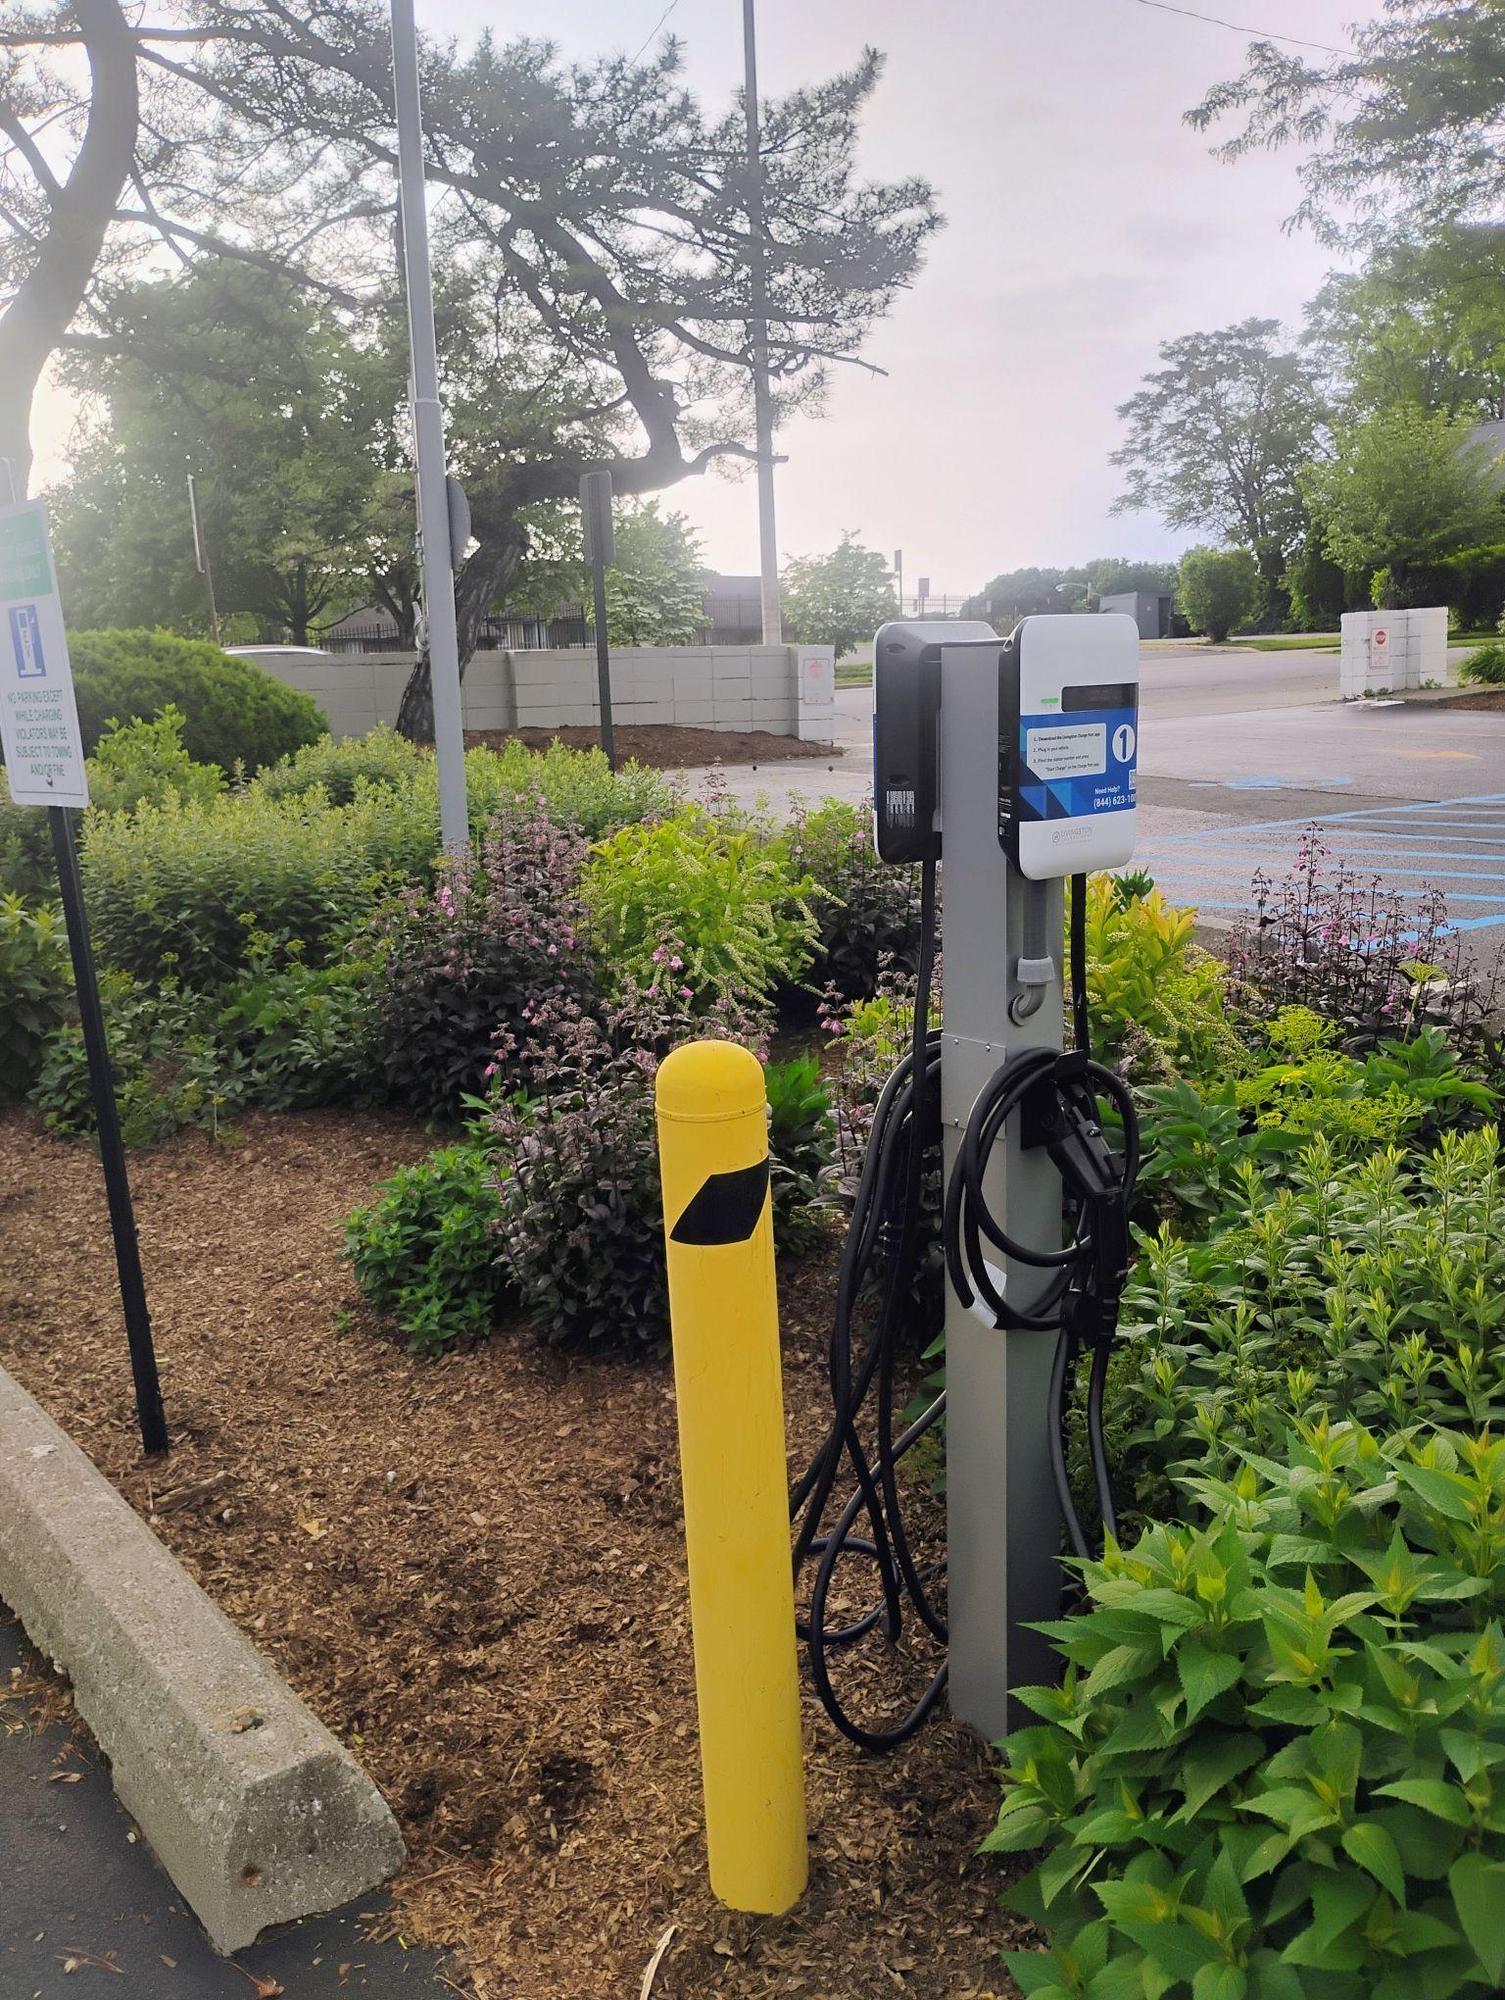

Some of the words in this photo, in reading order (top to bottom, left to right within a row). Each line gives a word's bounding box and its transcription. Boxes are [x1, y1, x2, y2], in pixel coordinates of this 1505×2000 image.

[7, 692, 17, 704] NO
[17, 691, 42, 703] PARKING
[43, 689, 63, 703] EXCEPT
[15, 709, 34, 721] WHILE
[34, 708, 63, 721] CHARGING
[16, 727, 47, 740] VIOLATORS
[47, 727, 59, 740] MAY
[59, 727, 67, 740] BE
[1119, 728, 1127, 760] 1
[16, 745, 42, 758] SUBJECT
[42, 745, 51, 758] TO
[51, 745, 72, 759] TOWING
[53, 764, 65, 777] FINE
[1094, 787, 1107, 795] Need
[1107, 785, 1121, 794] Help?
[1093, 796, 1112, 810] (844)
